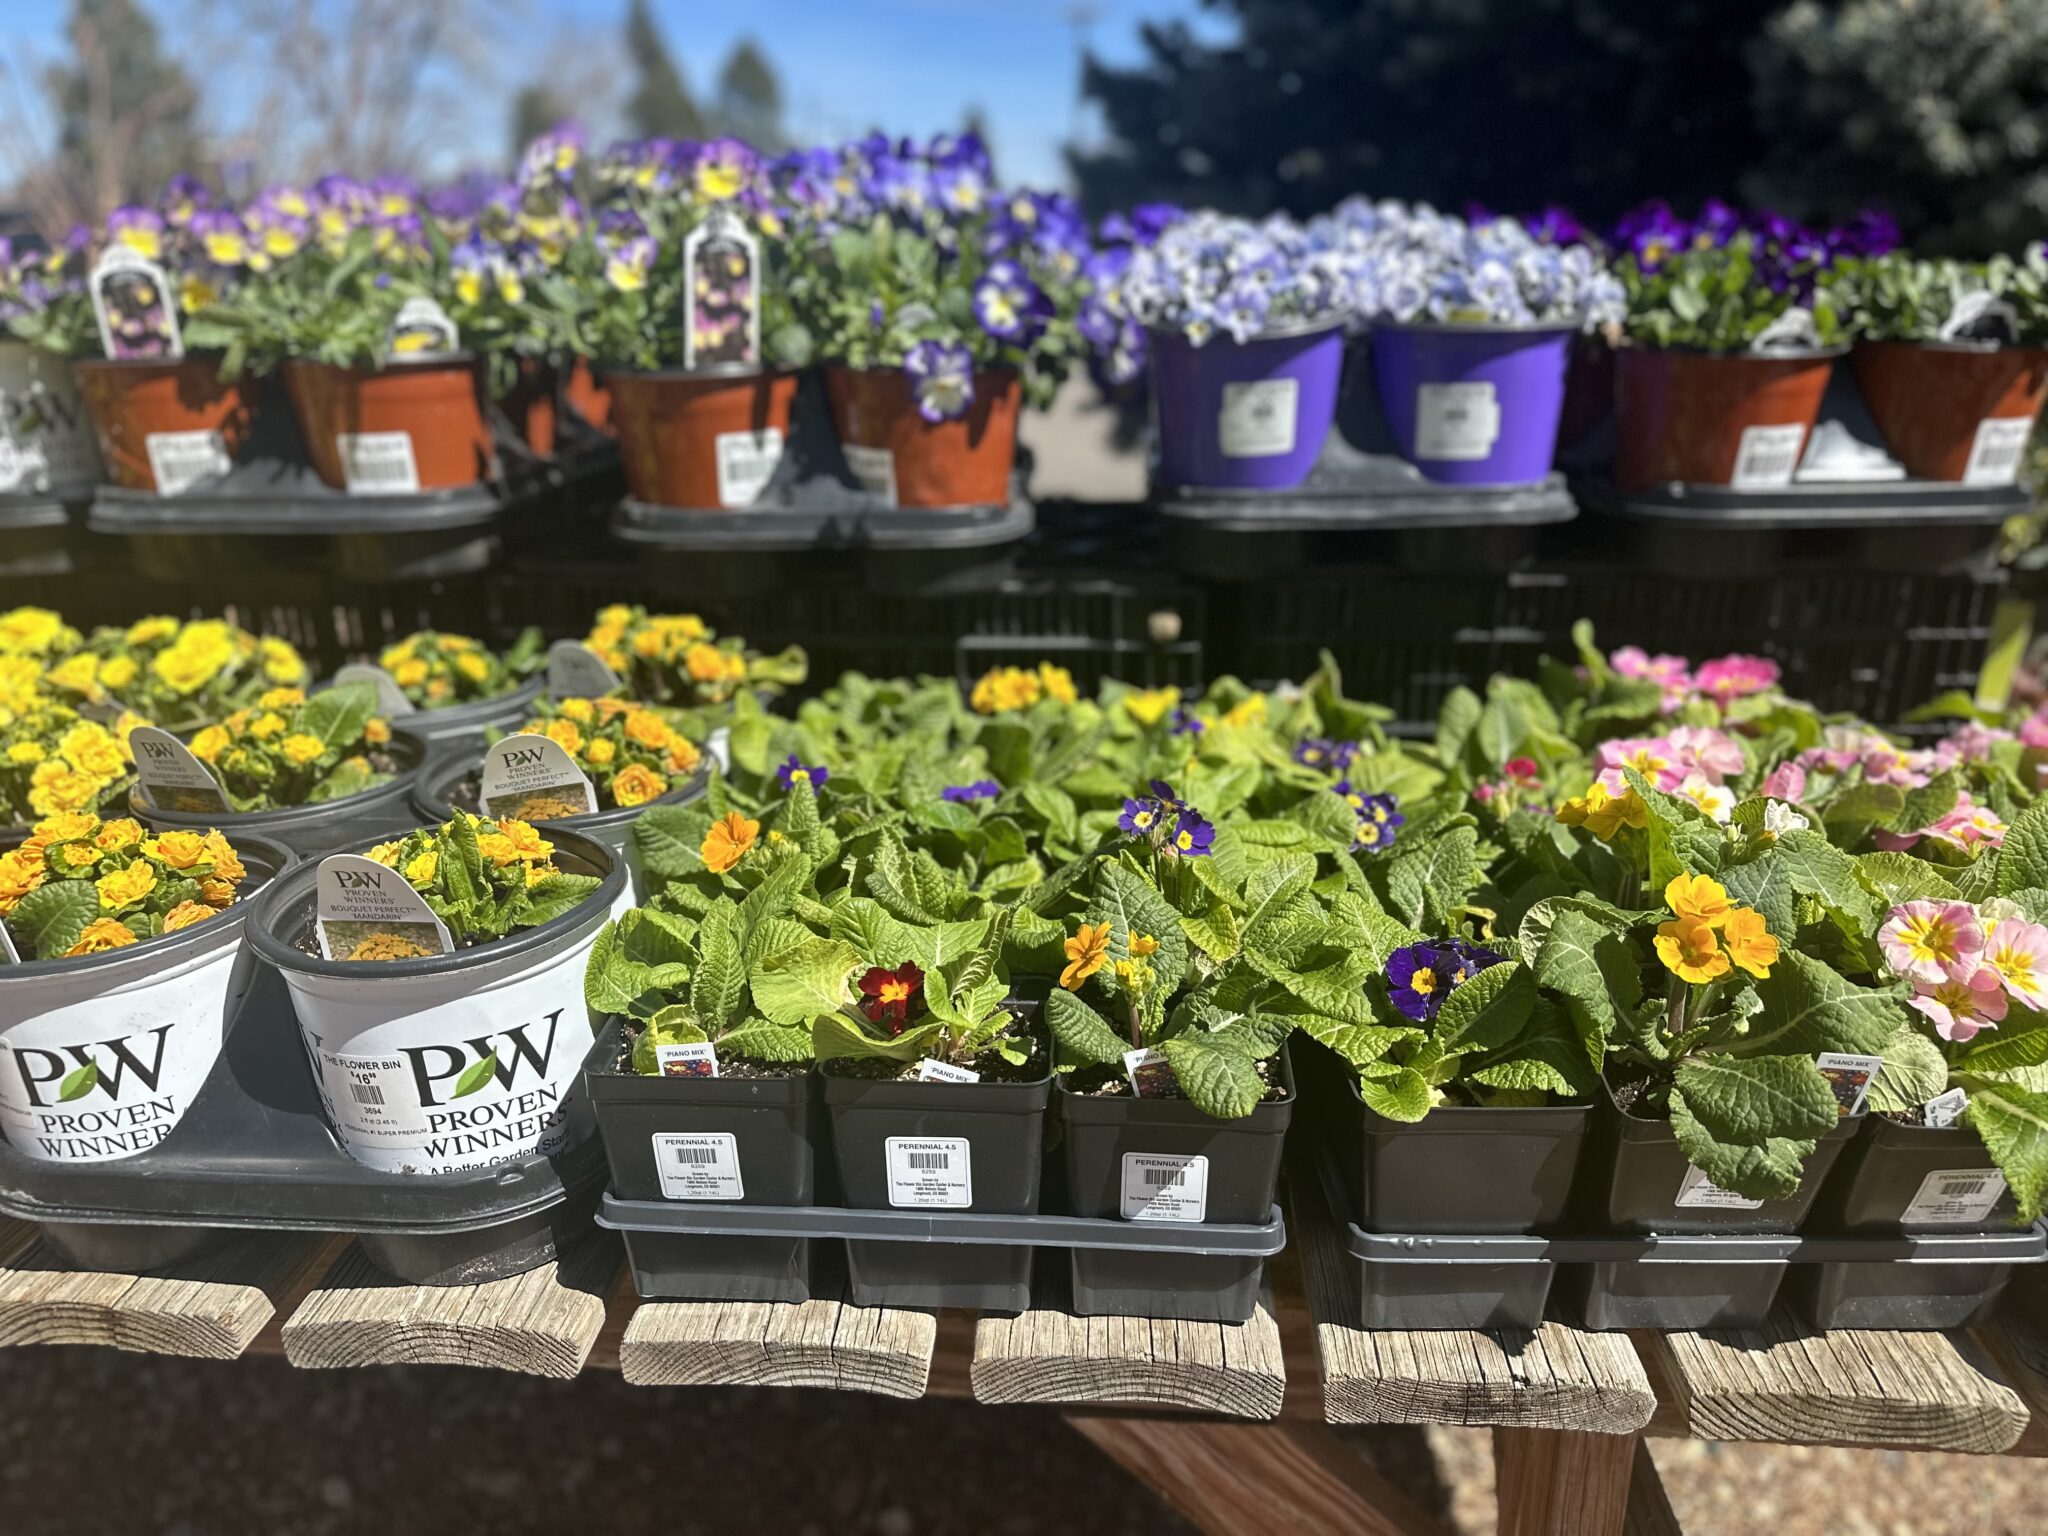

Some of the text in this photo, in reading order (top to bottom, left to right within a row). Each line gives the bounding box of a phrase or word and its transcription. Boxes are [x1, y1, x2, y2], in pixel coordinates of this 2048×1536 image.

[501, 746, 545, 768] PW
[509, 763, 545, 774] PROVEN
[494, 779, 531, 790] BOUQUET
[332, 870, 382, 889] PW
[345, 889, 387, 897] PROVEN
[13, 1023, 175, 1107] PW
[323, 1054, 402, 1070] THE FLOWER BIN
[397, 1007, 565, 1107] PW
[38, 1095, 175, 1133] PROVEN
[427, 1082, 557, 1134] PROVEN
[37, 1123, 172, 1158] WINNER
[398, 1128, 428, 1136] PREMIUM
[489, 1145, 539, 1166] Garden
[1135, 1158, 1181, 1167] PERENNIAL
